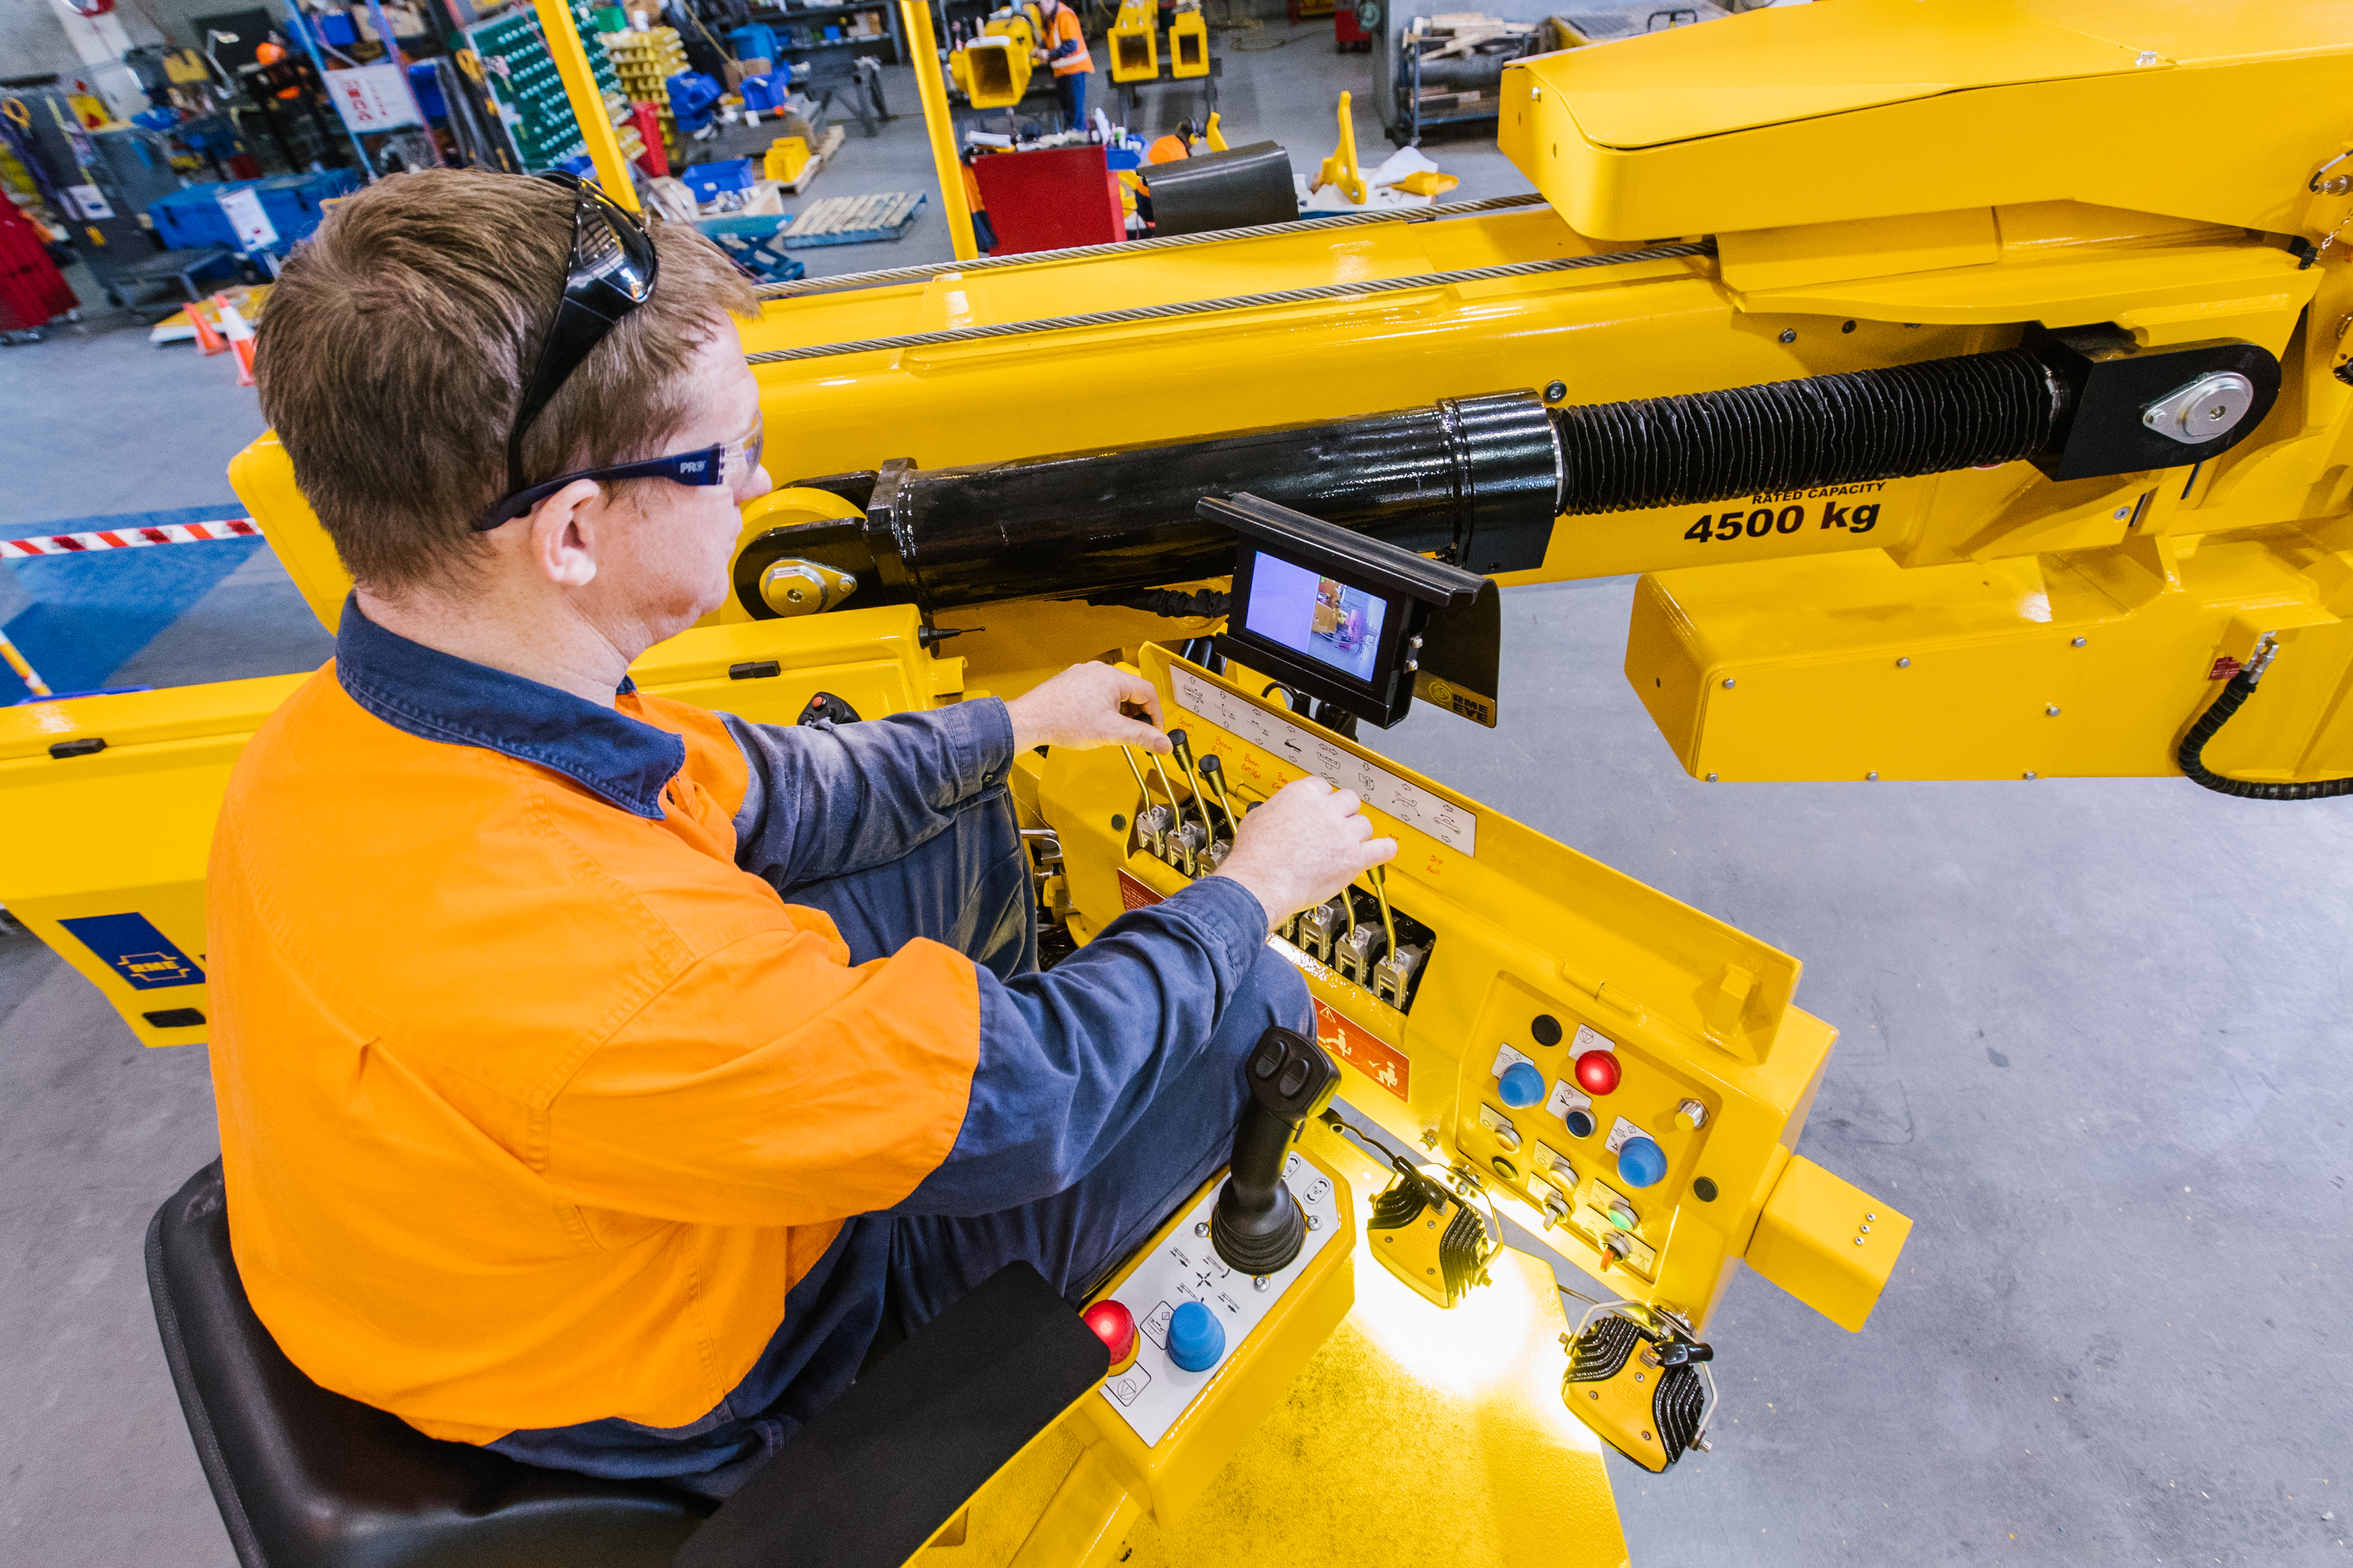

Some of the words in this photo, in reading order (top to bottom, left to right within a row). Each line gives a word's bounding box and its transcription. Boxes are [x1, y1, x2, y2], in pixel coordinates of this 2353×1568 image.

[680, 460, 706, 474] PRO
[1752, 491, 1802, 505] RATED
[1808, 482, 1887, 498] CAPACITY
[1684, 505, 1804, 543] 4500
[1820, 501, 1881, 533] kg
[1453, 694, 1488, 714] RME
[1453, 703, 1487, 724] EYE
[1178, 716, 1194, 729] Boom
[1215, 736, 1232, 753] Boom
[1244, 753, 1259, 768] Boom
[1277, 772, 1288, 785] Boo
[1427, 865, 1441, 876] Roll
[128, 961, 180, 973] RME
